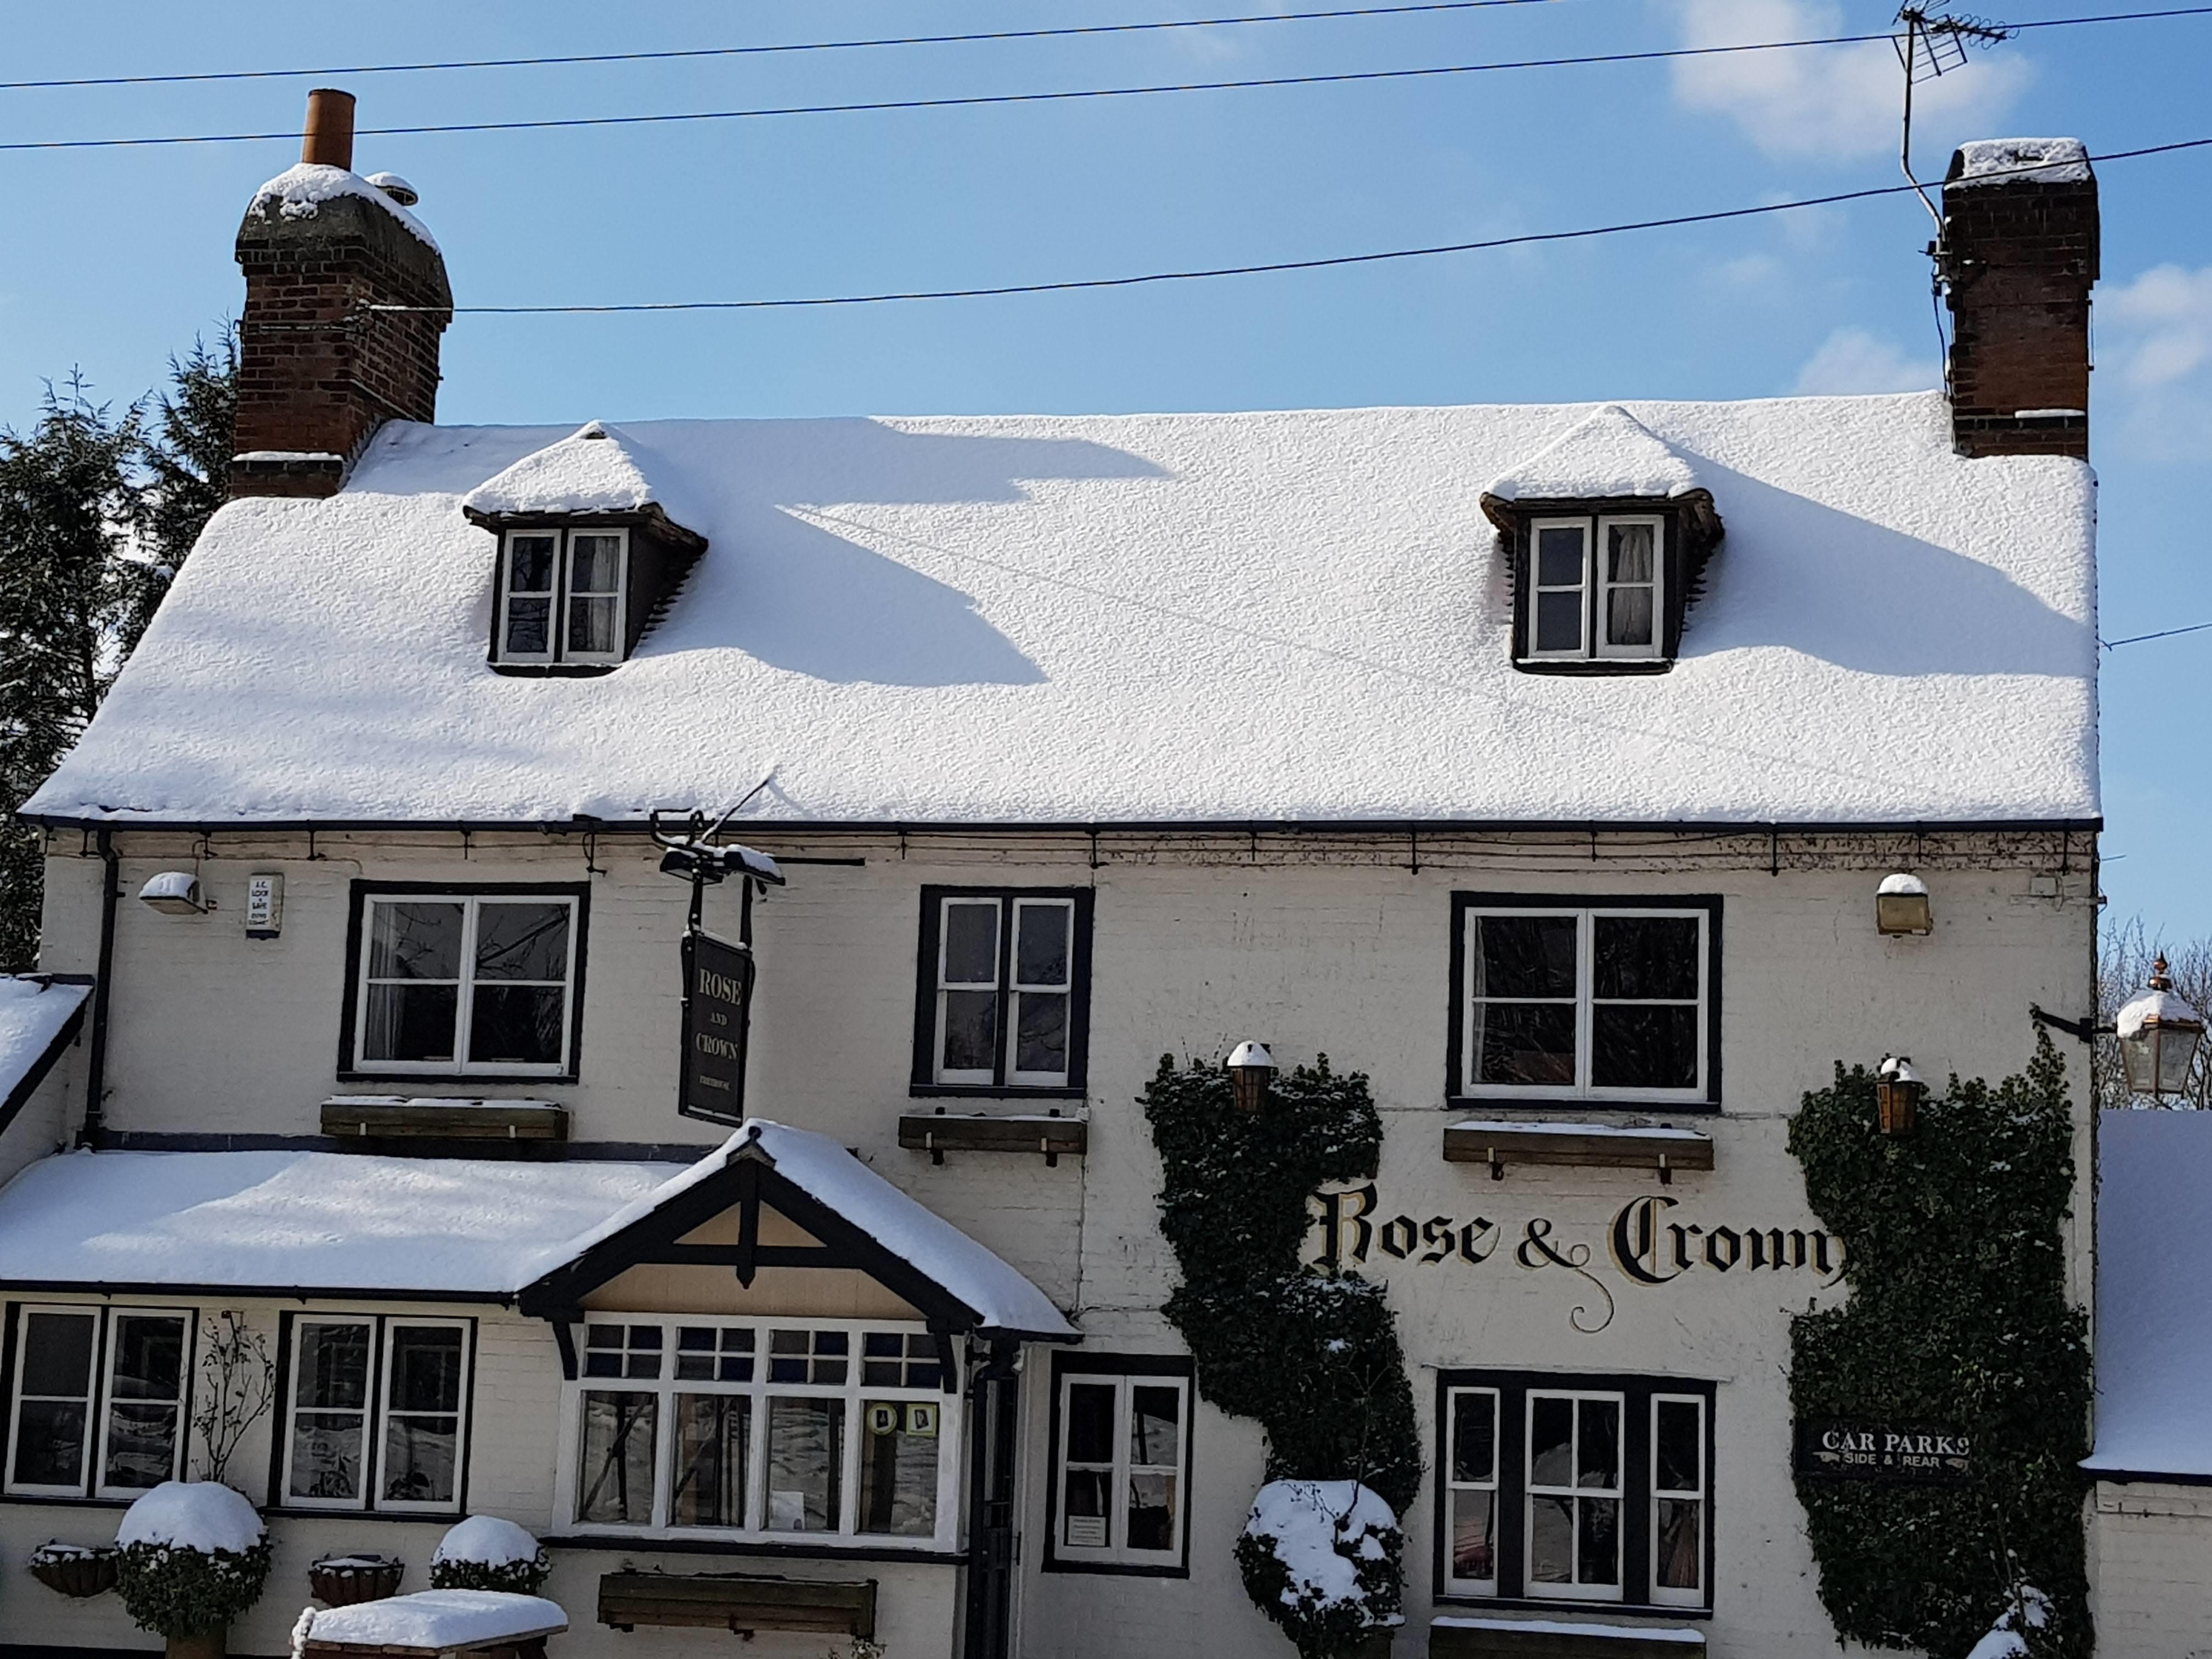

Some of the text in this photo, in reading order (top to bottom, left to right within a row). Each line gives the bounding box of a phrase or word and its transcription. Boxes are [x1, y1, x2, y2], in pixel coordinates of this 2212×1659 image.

[699, 968, 742, 1006] ROSE
[711, 1012, 727, 1026] AND
[696, 1032, 738, 1059] CROWN
[1306, 1182, 1501, 1274] Rose
[1606, 1195, 1852, 1290] Crown
[1822, 1431, 1876, 1451] CAR
[1844, 1452, 1940, 1468] SIDE & REAR
